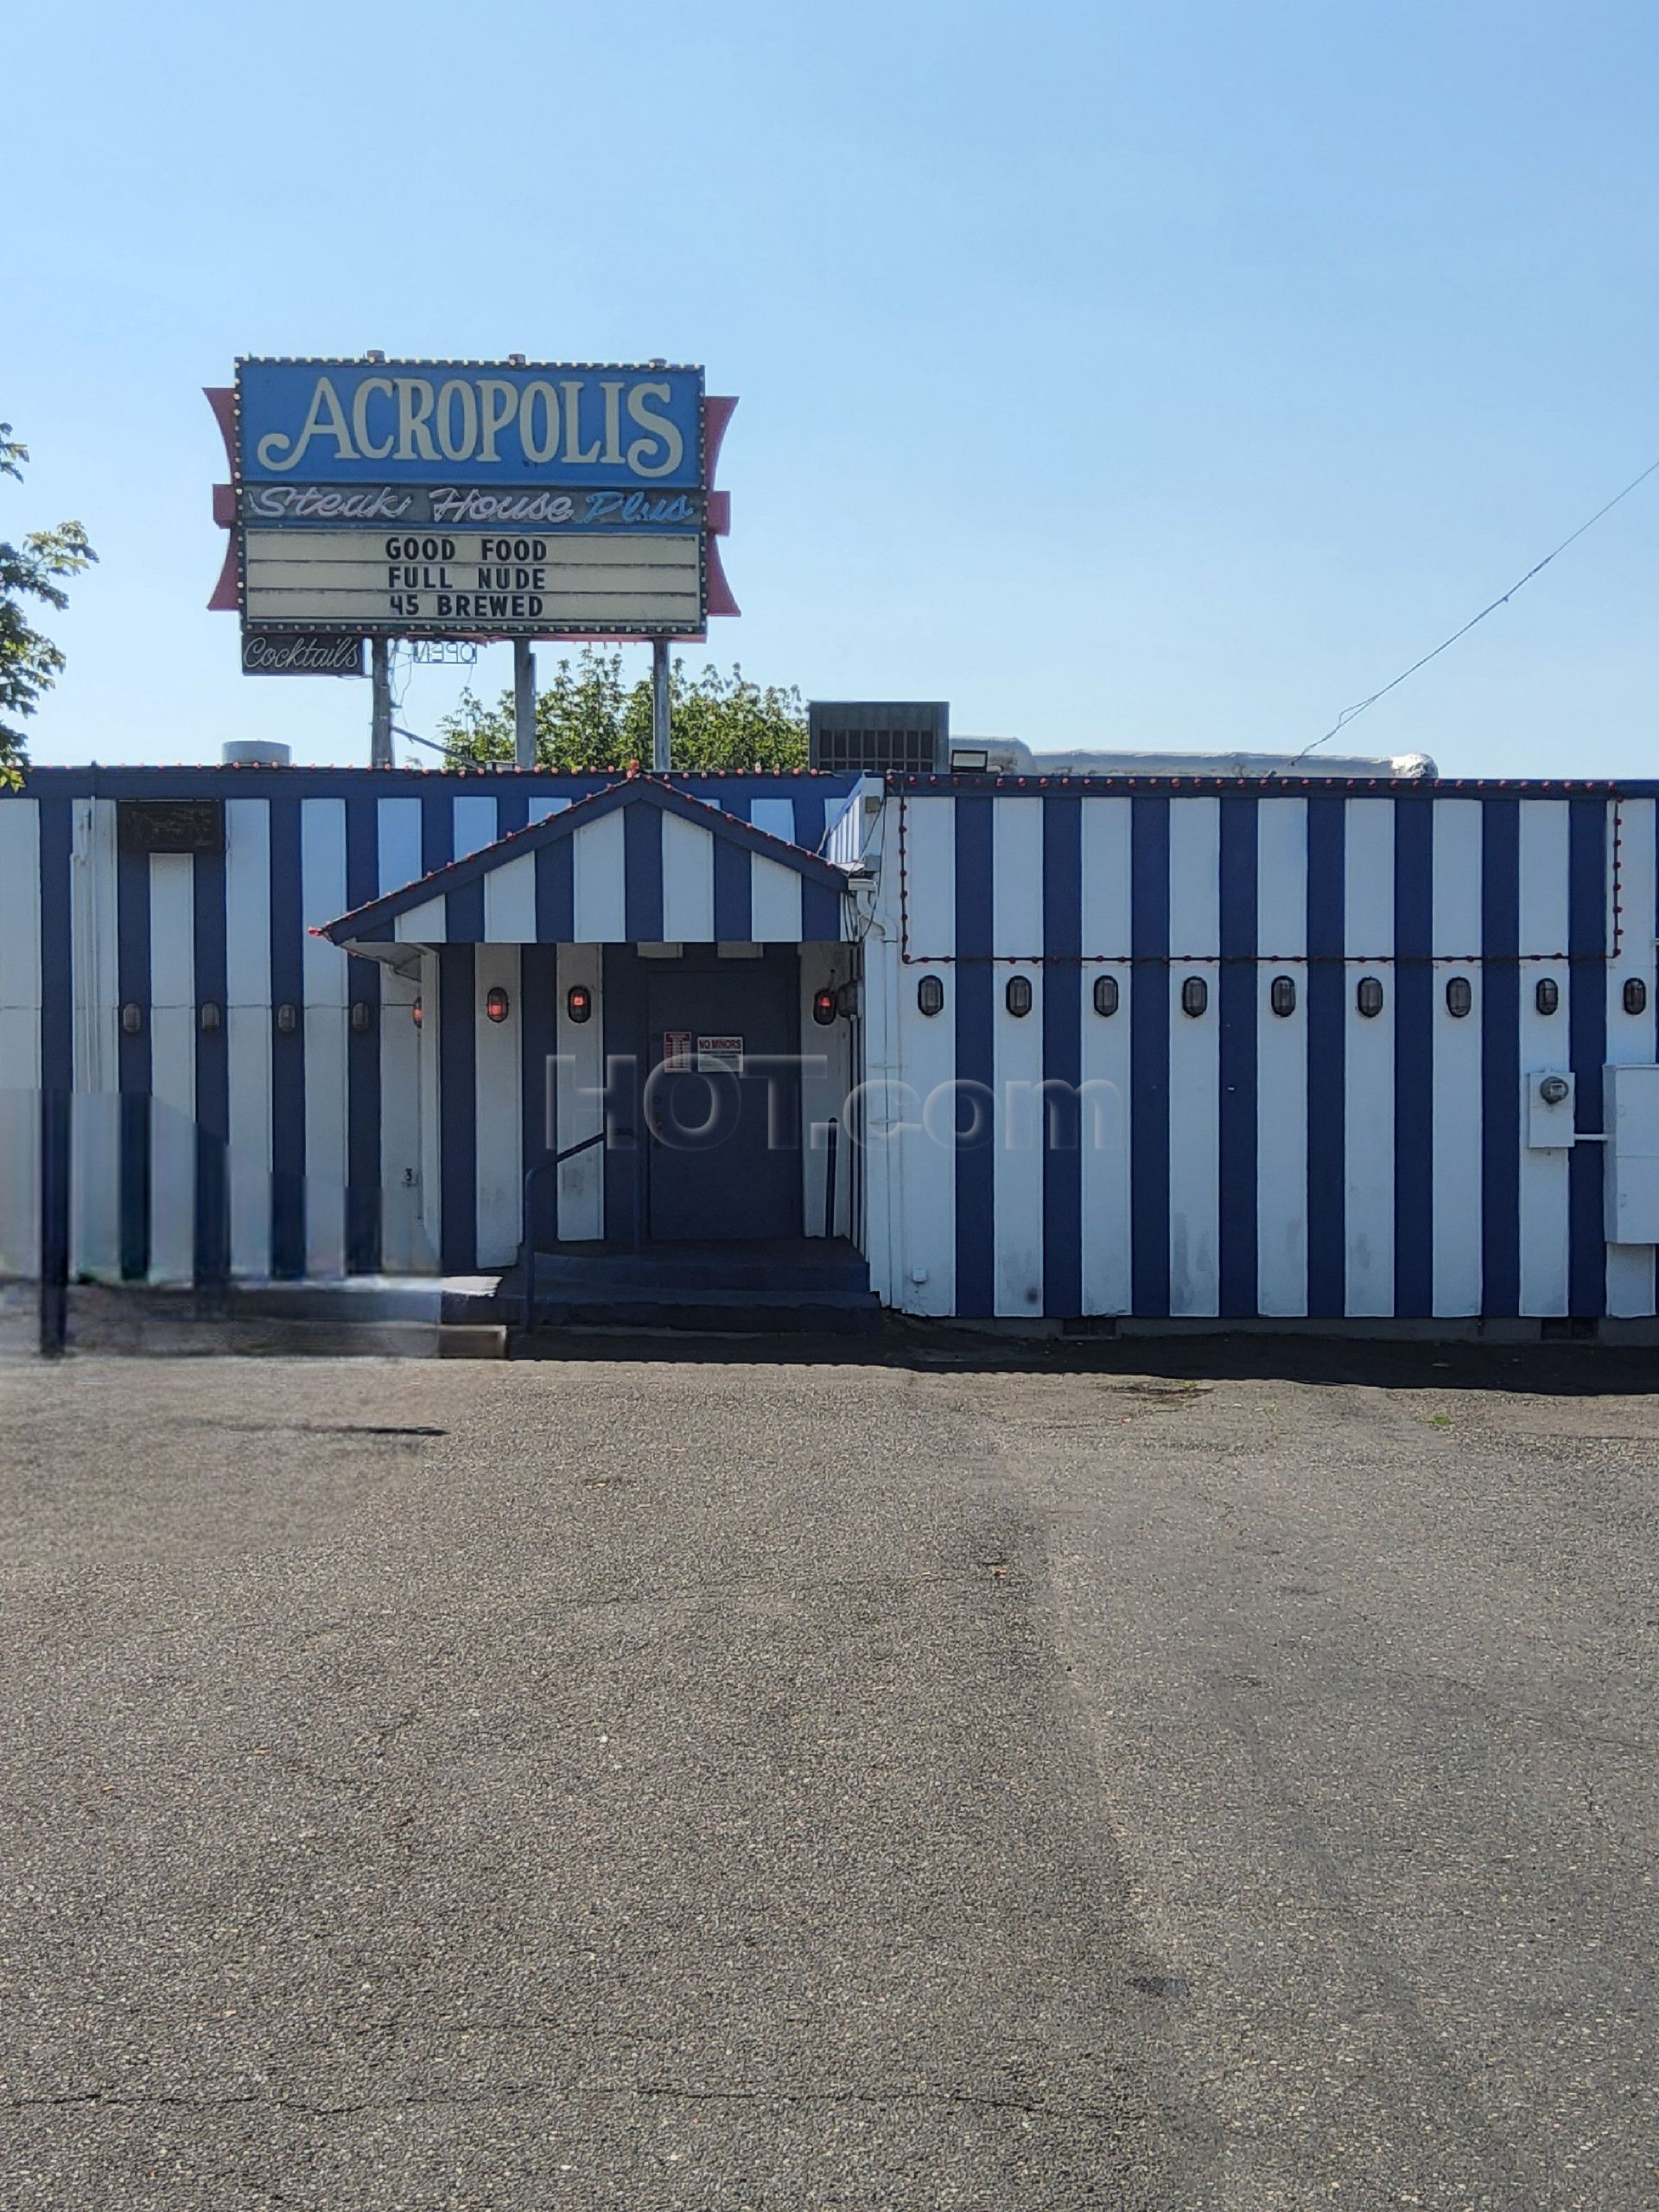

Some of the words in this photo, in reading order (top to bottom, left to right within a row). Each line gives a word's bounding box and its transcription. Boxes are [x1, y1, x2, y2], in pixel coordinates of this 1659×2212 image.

[257, 376, 685, 478] ACROPOLIS
[248, 486, 412, 518] Steak
[429, 487, 575, 523] House
[582, 490, 694, 524] Plus
[385, 537, 456, 561] GOOD
[480, 538, 547, 562] FOOD
[388, 566, 454, 589] FULL
[478, 568, 546, 590] NUDE
[390, 594, 420, 616] 45
[437, 594, 543, 617] BREWED
[245, 637, 359, 668] Cocktails
[699, 1039, 711, 1050] NO
[711, 1039, 741, 1050] MINORS
